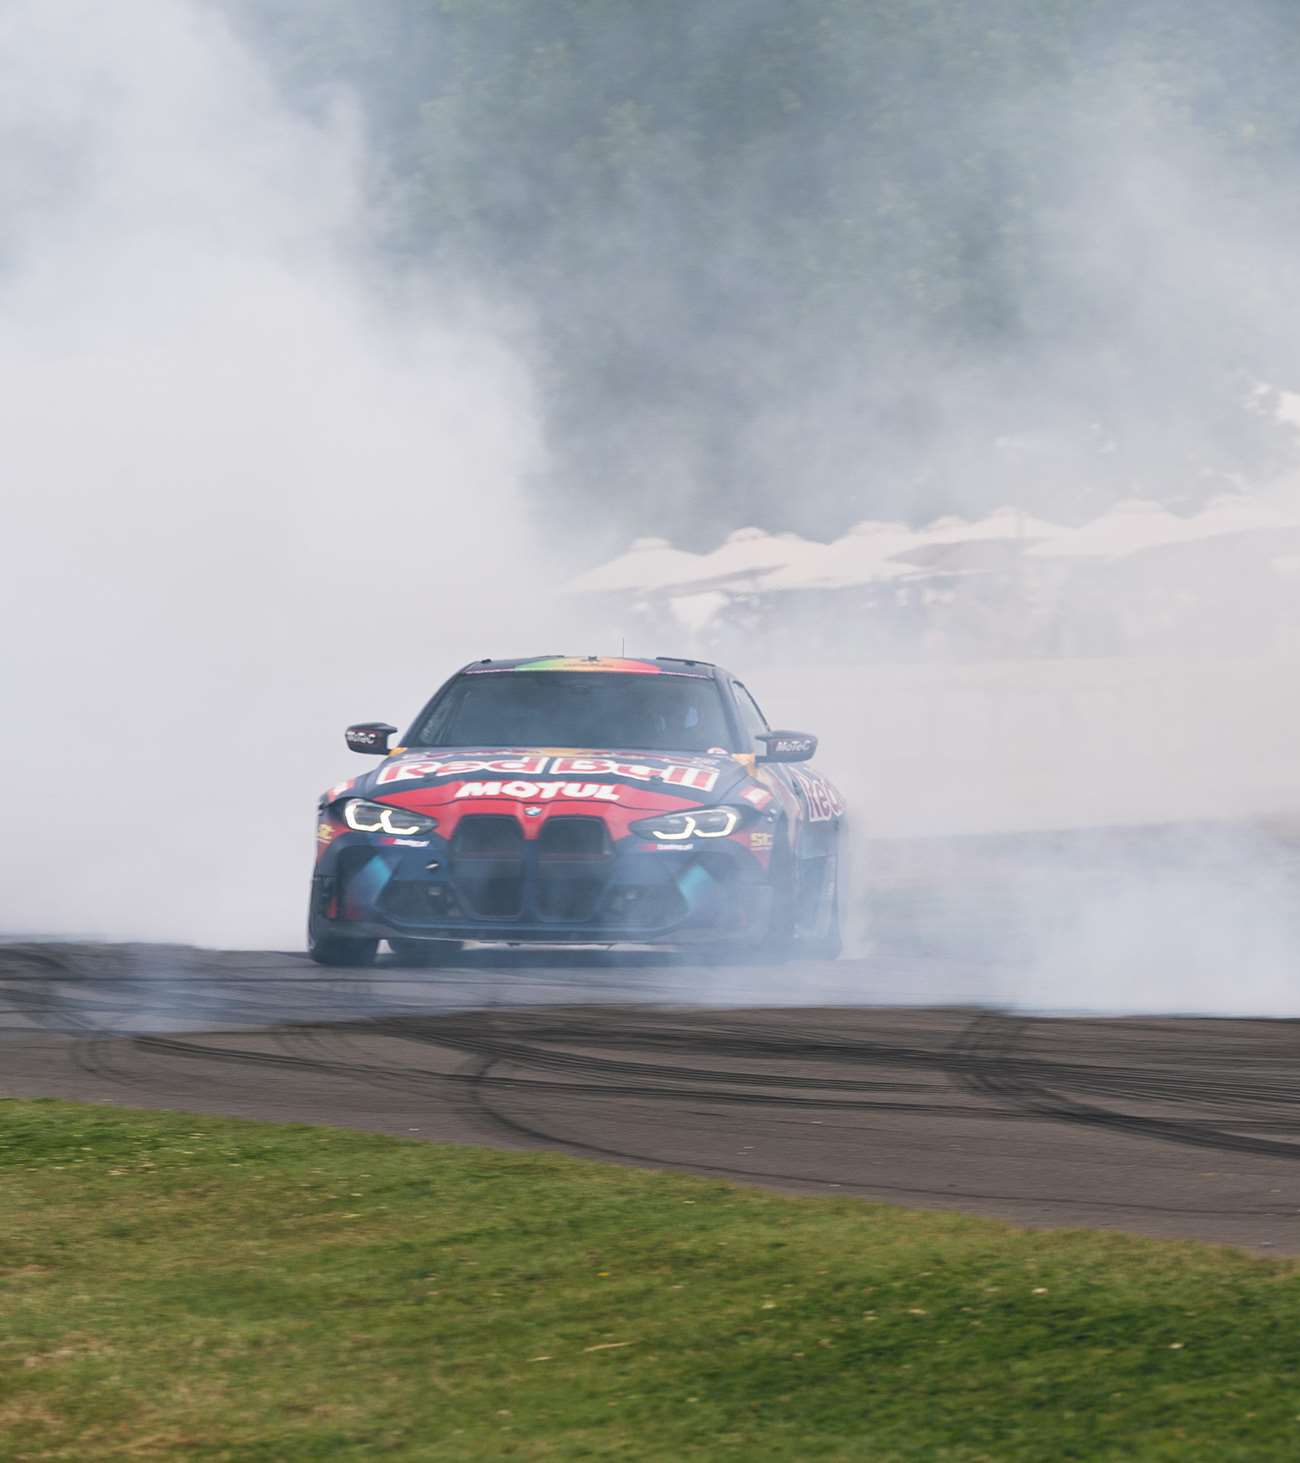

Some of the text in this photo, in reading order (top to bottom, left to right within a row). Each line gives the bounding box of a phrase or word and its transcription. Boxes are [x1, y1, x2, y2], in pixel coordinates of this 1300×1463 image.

[376, 757, 720, 792] Red Bull
[454, 781, 621, 800] MOTUL
